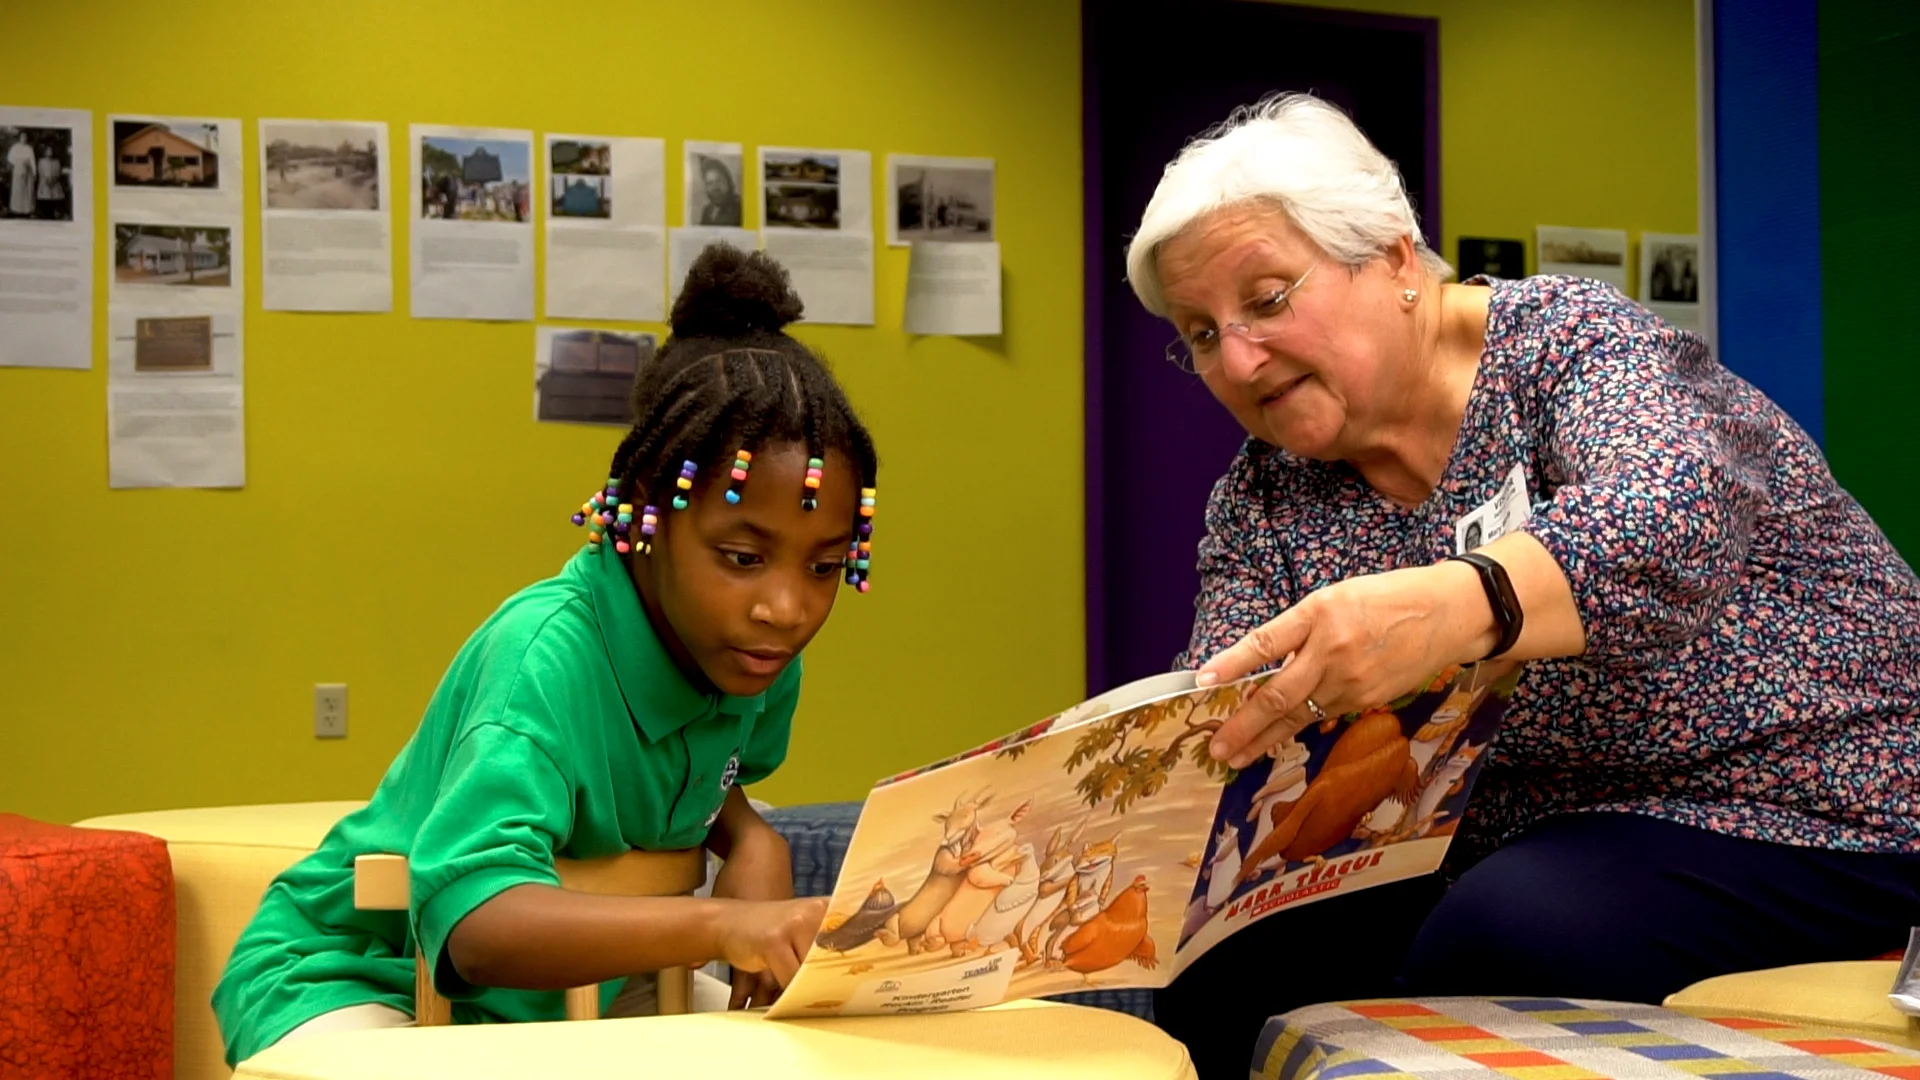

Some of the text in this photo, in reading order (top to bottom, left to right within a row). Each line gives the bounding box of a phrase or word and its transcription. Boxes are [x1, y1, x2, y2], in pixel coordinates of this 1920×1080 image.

[1223, 851, 1385, 922] MARK TEAGUE
[1260, 880, 1339, 912] SCHOLASTIC
[892, 986, 970, 1001] Kindergarten
